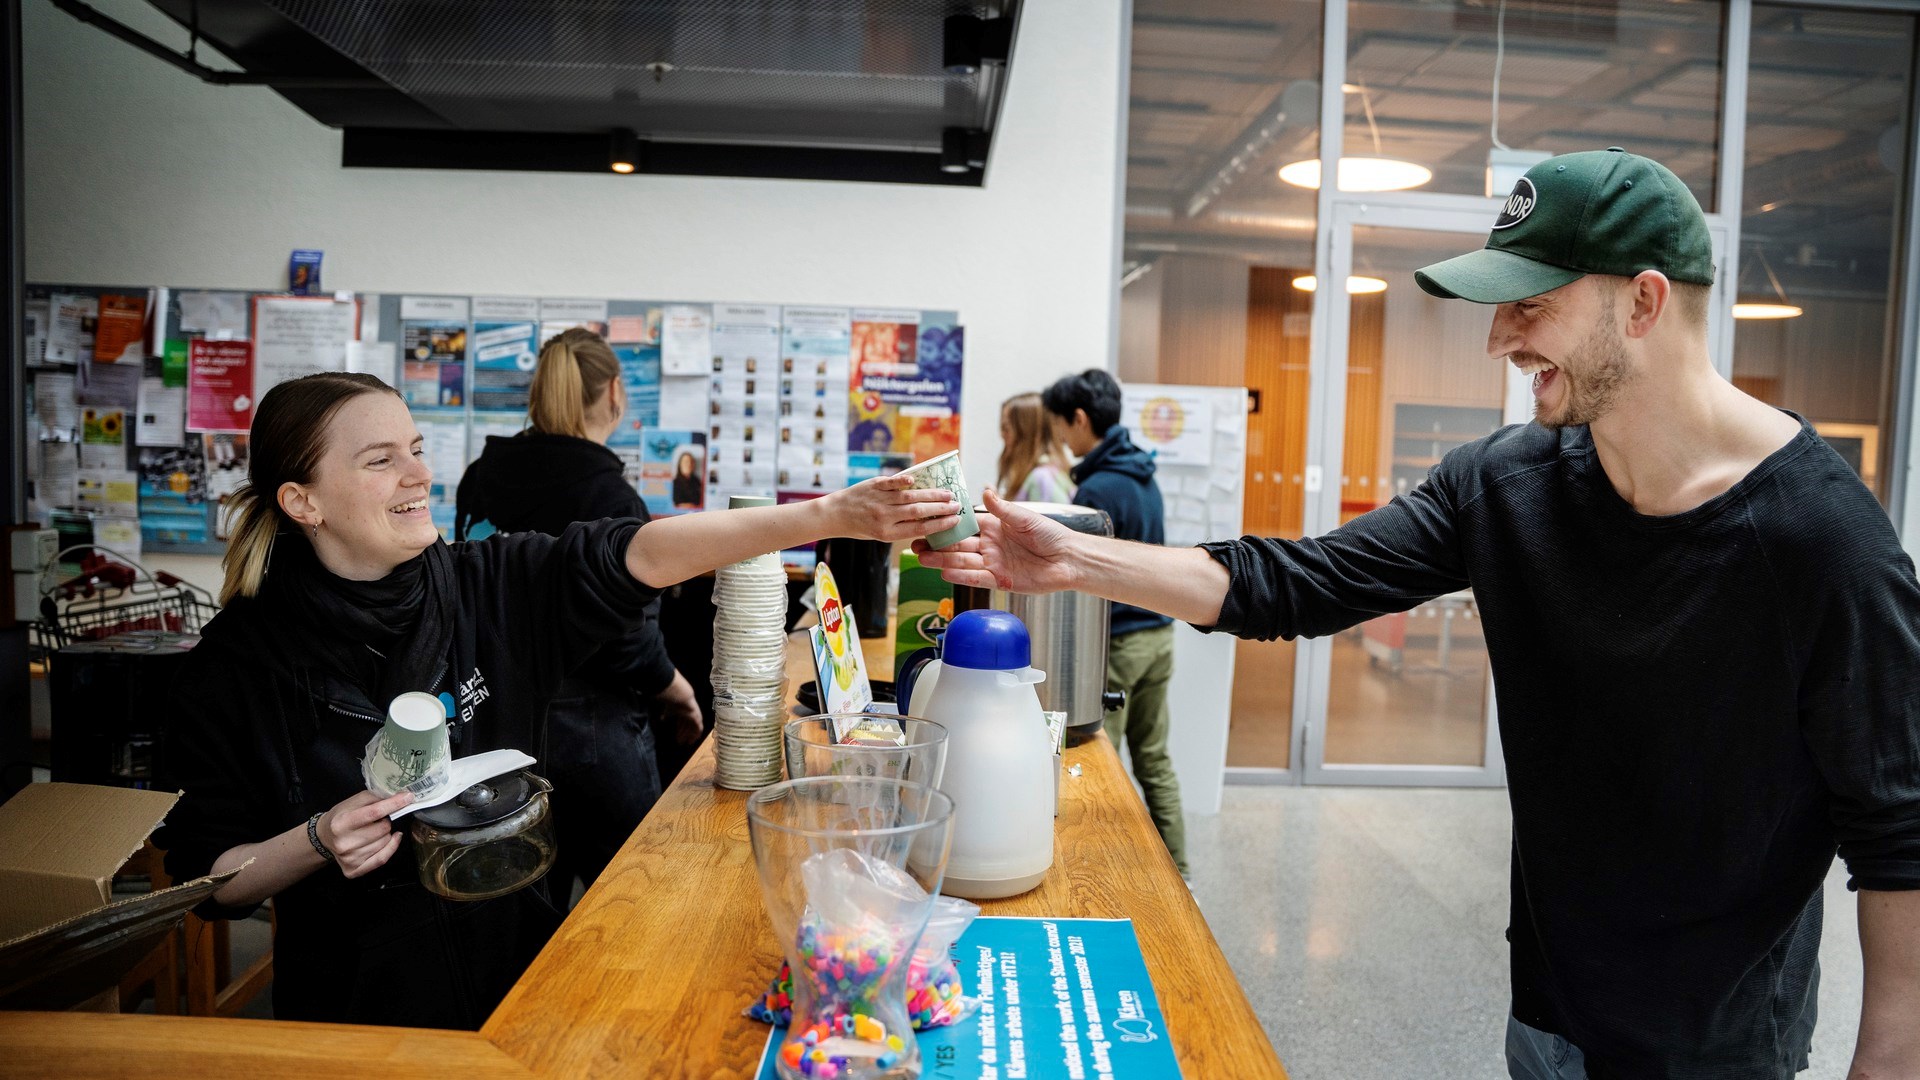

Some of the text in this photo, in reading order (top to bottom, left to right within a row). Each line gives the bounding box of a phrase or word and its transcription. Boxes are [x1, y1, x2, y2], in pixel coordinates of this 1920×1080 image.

[1503, 194, 1532, 218] NDR
[823, 607, 840, 629] Lipton
[1067, 936, 1086, 955] 2021?
[1048, 948, 1066, 977] Student
[1074, 955, 1094, 990] semester
[1002, 978, 1020, 1005] under
[1052, 977, 1069, 990] the
[1053, 990, 1071, 1000] of
[981, 1002, 995, 1014] av
[1055, 1000, 1074, 1024] work
[1082, 989, 1101, 1024] autumn
[1117, 990, 1138, 1019] Kåren
[977, 1014, 996, 1047] märkt
[1004, 1006, 1024, 1038] arbete
[1059, 1024, 1078, 1042] the
[1086, 1023, 1105, 1041] the
[935, 1045, 955, 1068] YES
[978, 1048, 998, 1063] du
[1004, 1039, 1027, 1078] Kårens
[1090, 1041, 1112, 1073] during
